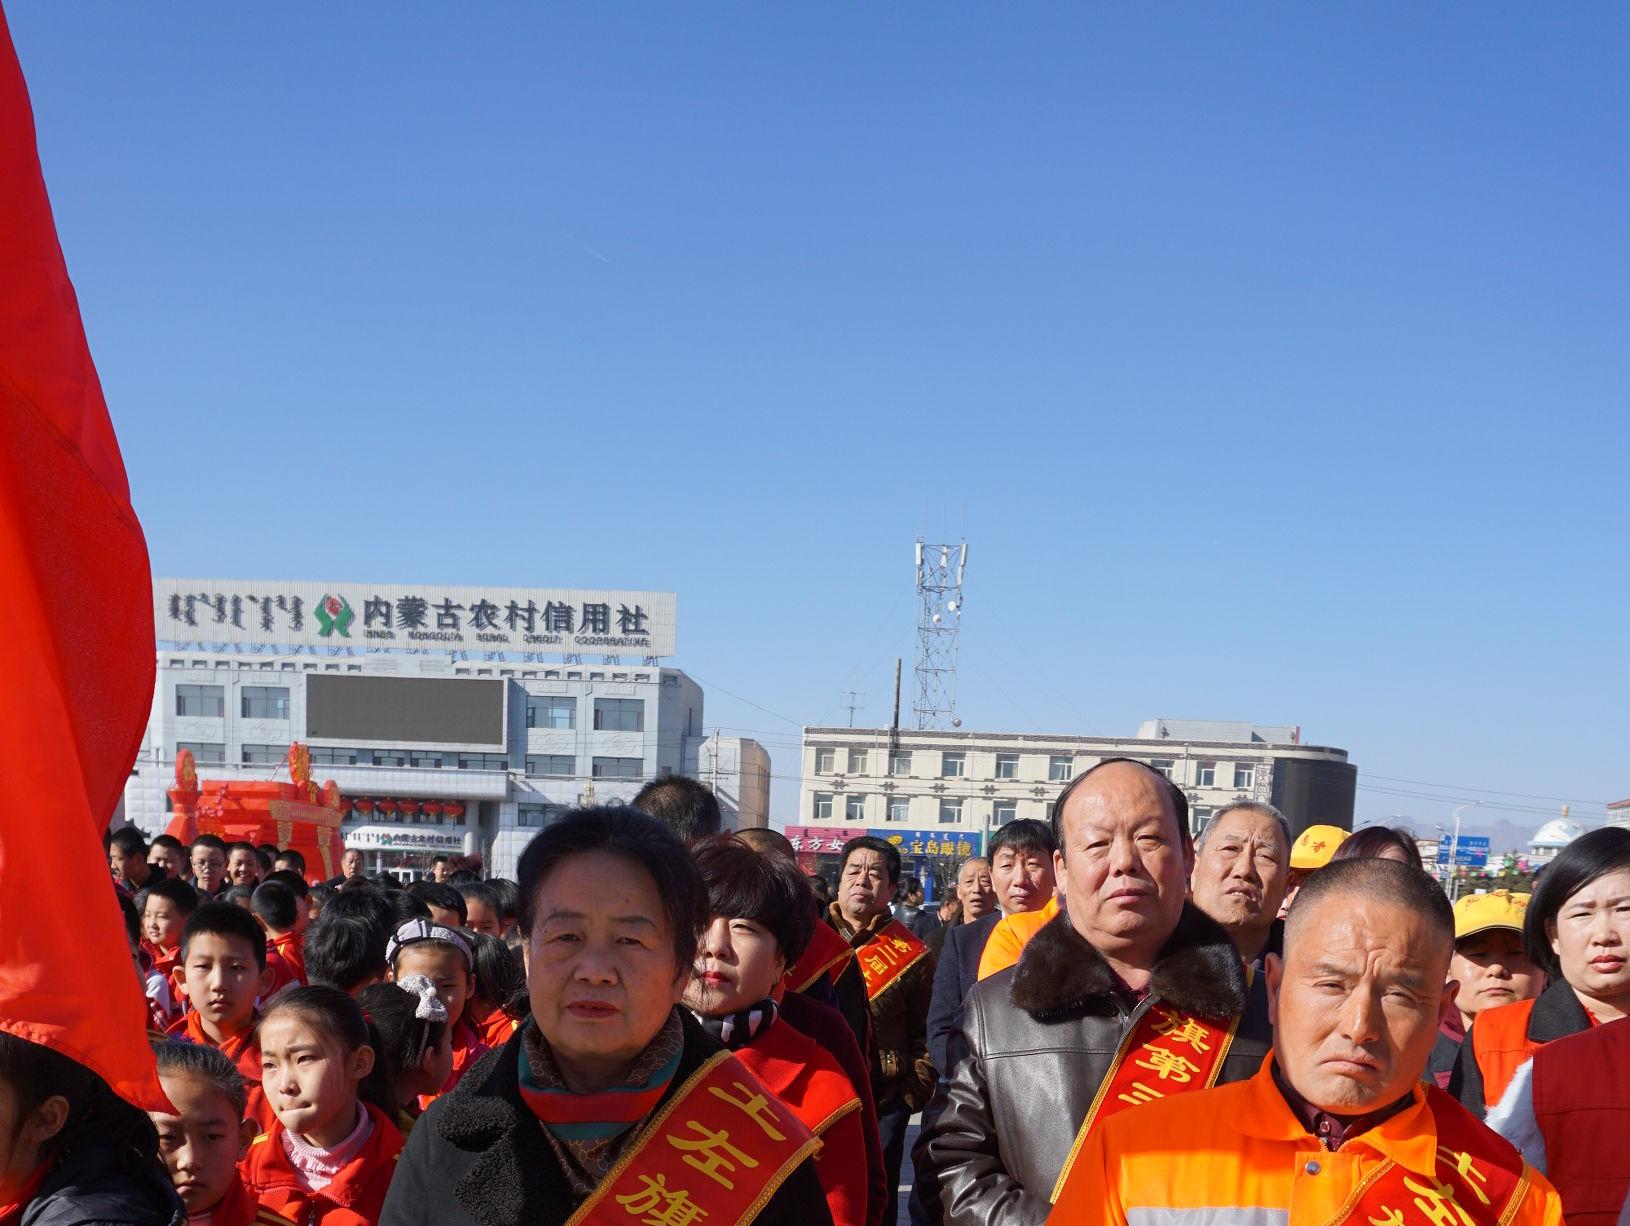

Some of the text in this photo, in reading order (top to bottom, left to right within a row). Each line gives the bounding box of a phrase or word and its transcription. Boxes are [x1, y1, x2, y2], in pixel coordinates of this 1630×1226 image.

[363, 594, 650, 635] 内蒙古农村信用社
[408, 631, 464, 642] MONGOLIA
[476, 632, 511, 643] RURAL
[522, 634, 563, 645] CREDIT
[910, 840, 972, 856] 宝岛眼镜
